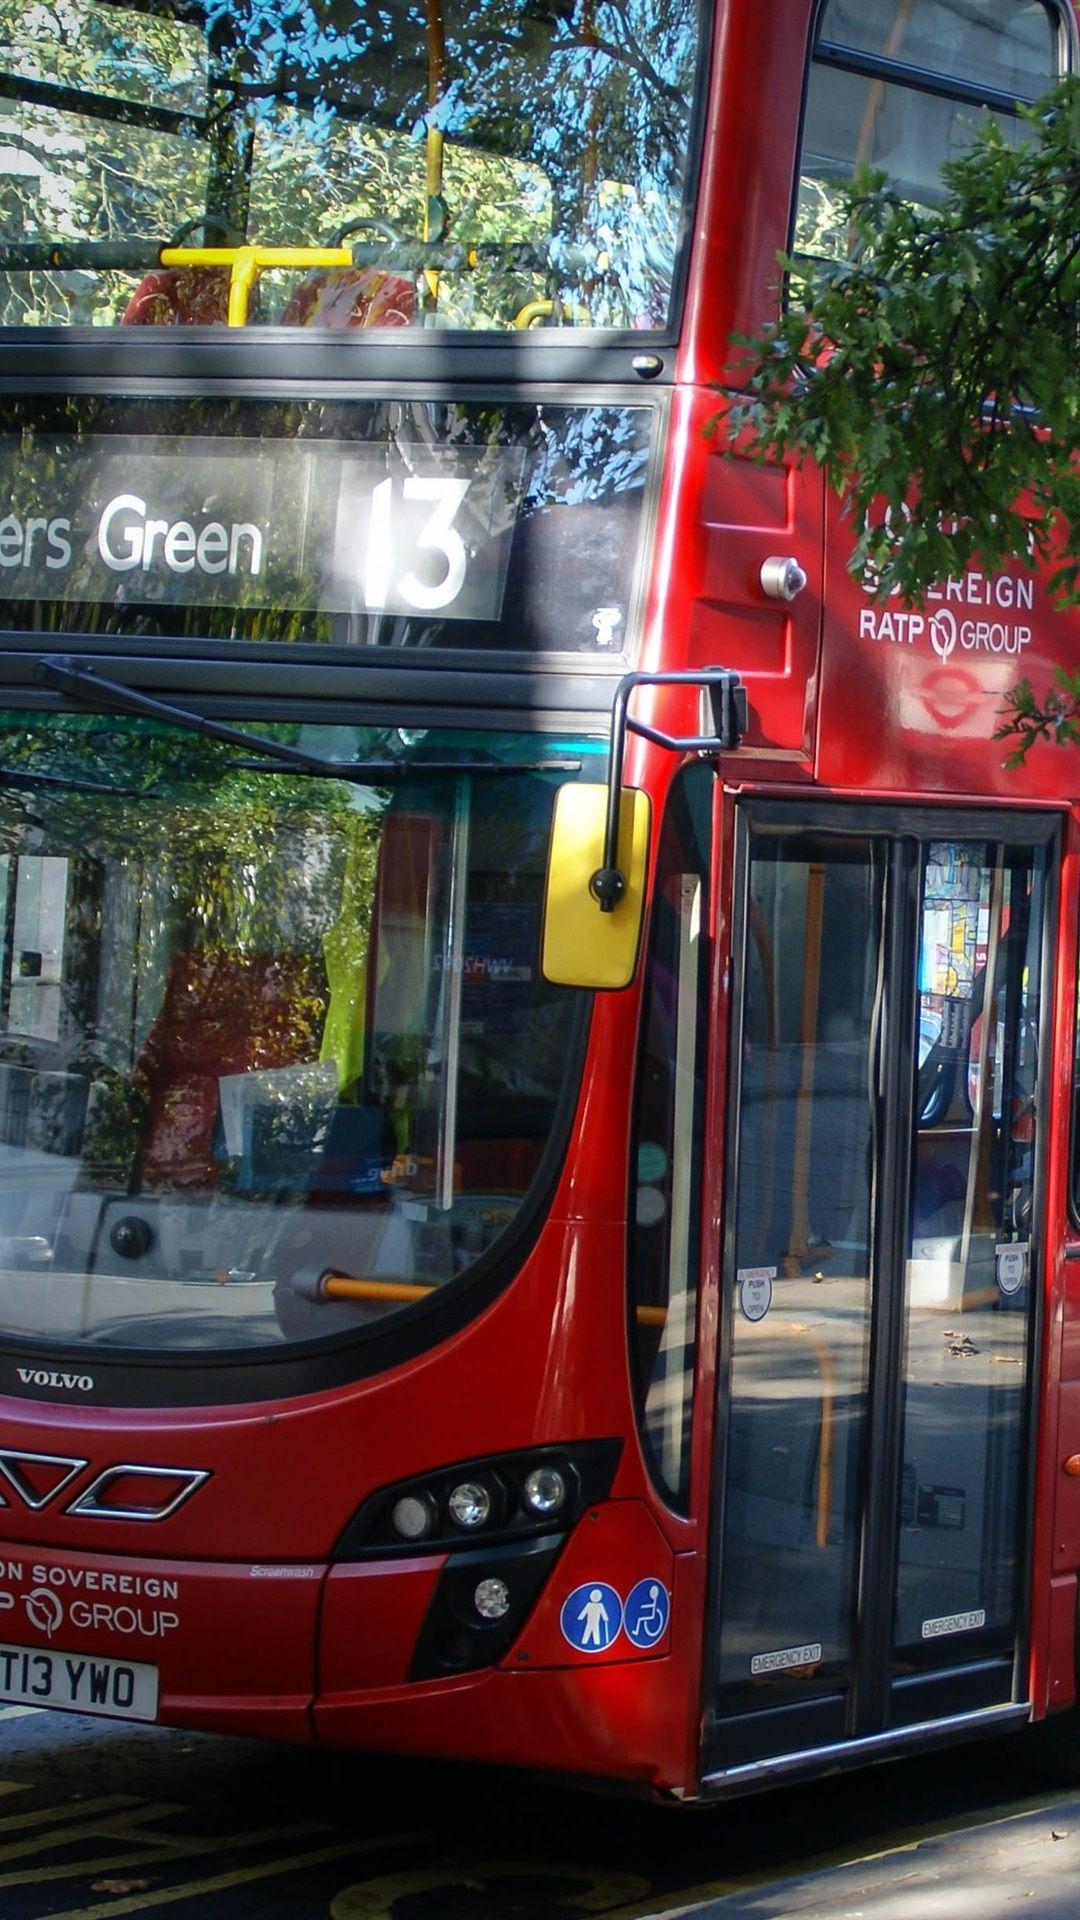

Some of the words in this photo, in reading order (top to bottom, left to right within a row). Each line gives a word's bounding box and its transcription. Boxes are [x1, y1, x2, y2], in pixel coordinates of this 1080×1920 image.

[0, 515, 72, 569] ers
[98, 494, 262, 574] Green
[365, 477, 472, 610] 13
[859, 609, 925, 643] RATP
[960, 620, 1032, 653] GROUP
[16, 1368, 94, 1391] VOLVO
[32, 1564, 178, 1599] SOVEREIGN
[250, 1564, 315, 1577] Screenwash
[69, 1600, 179, 1637] GROUP
[923, 1614, 969, 1637] EMERGENCY
[970, 1611, 984, 1627] EXIT
[752, 1649, 802, 1672] EMERGENCY
[803, 1645, 820, 1661] EXIT
[65, 1659, 135, 1708] YWO
